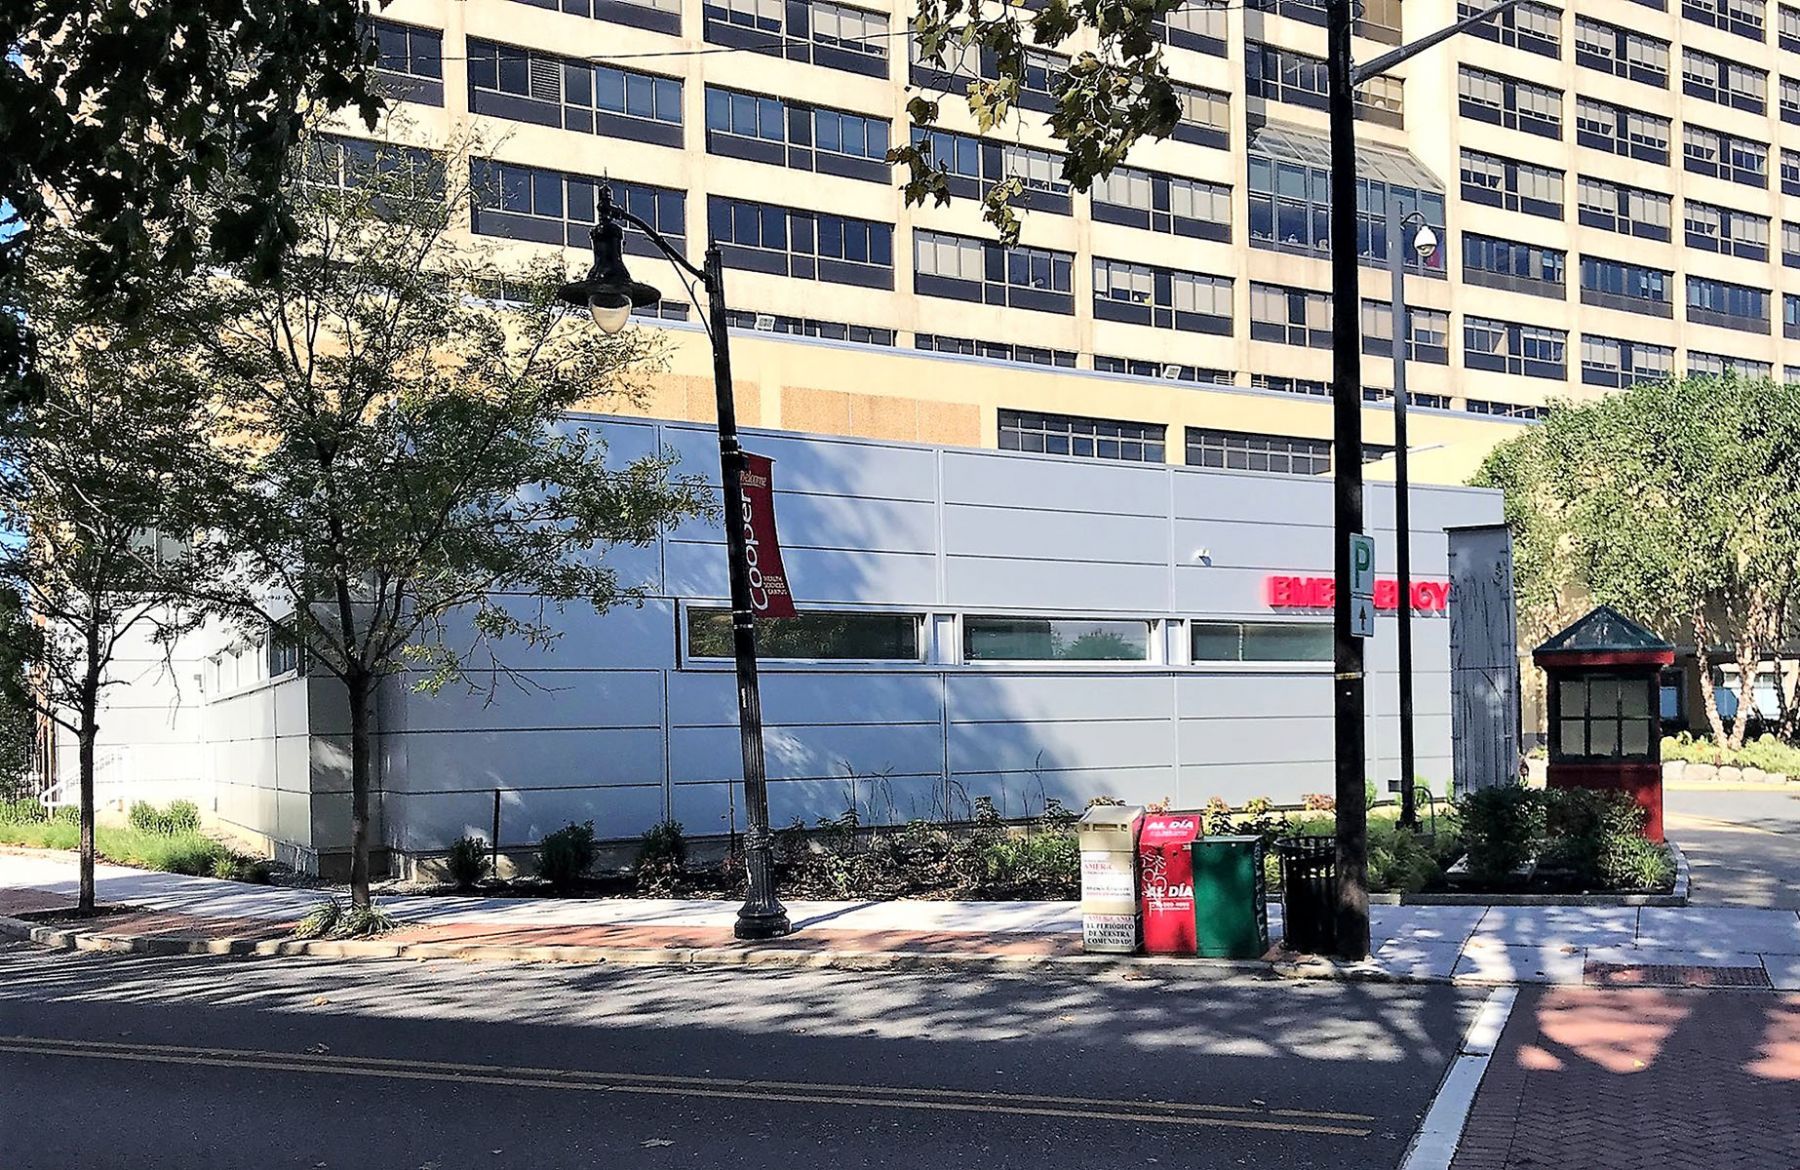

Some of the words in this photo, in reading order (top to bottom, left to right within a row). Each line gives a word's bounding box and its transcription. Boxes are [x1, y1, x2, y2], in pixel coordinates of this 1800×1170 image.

[741, 488, 769, 611] Cooper
[1354, 541, 1370, 588] P
[1271, 576, 1450, 610] EMEECY
[1147, 821, 1165, 829] AL
[1169, 819, 1194, 828] DÍA
[1146, 885, 1165, 897] AL
[1168, 882, 1194, 897] DÍA
